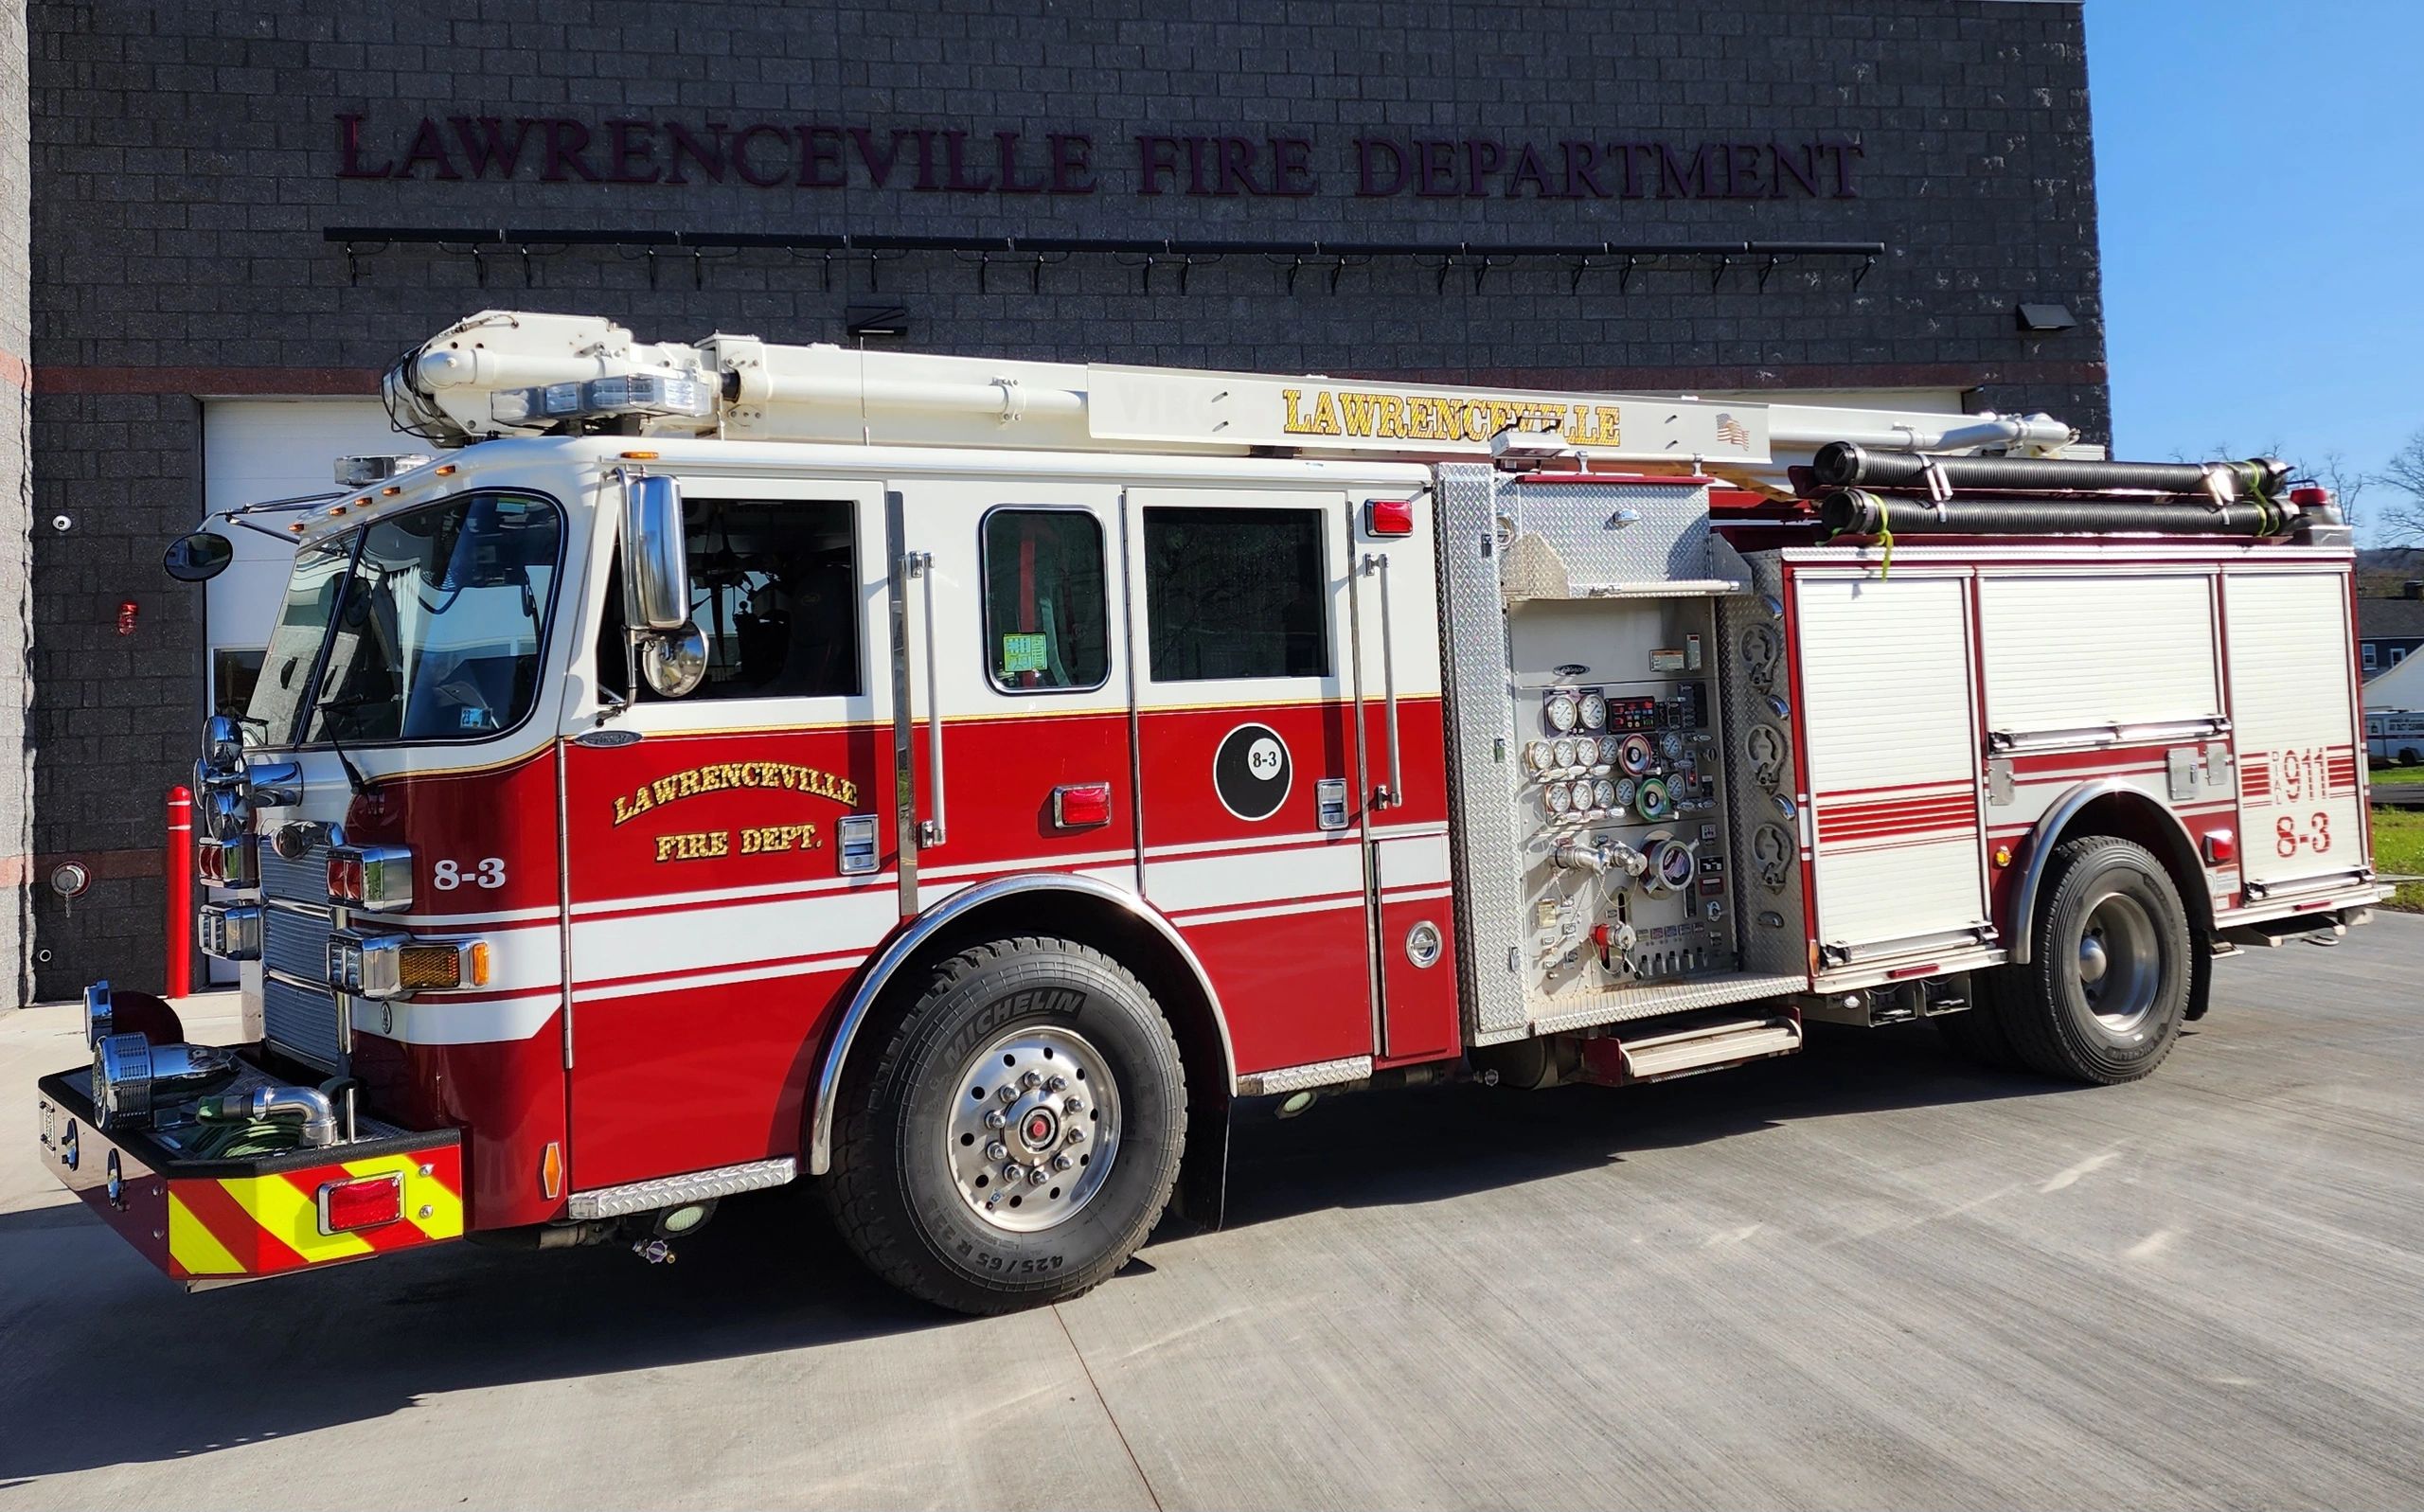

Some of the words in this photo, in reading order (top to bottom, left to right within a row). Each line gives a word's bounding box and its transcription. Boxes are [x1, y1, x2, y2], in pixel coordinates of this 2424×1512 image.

[335, 113, 1096, 194] LAWRENCEVILLE
[1137, 135, 1313, 198] FIRE
[1353, 137, 1864, 200] DEPARTMENT
[1252, 751, 1277, 768] 8-3
[2272, 751, 2282, 805] DIAL
[2283, 747, 2326, 804] 911
[613, 761, 858, 827] LAWRENCEVILLE
[655, 831, 729, 863] FIRE
[740, 824, 823, 855] DEPT.
[2275, 811, 2331, 858] 8-3
[434, 857, 506, 891] 8-3
[943, 990, 1084, 1069] MICHELIN
